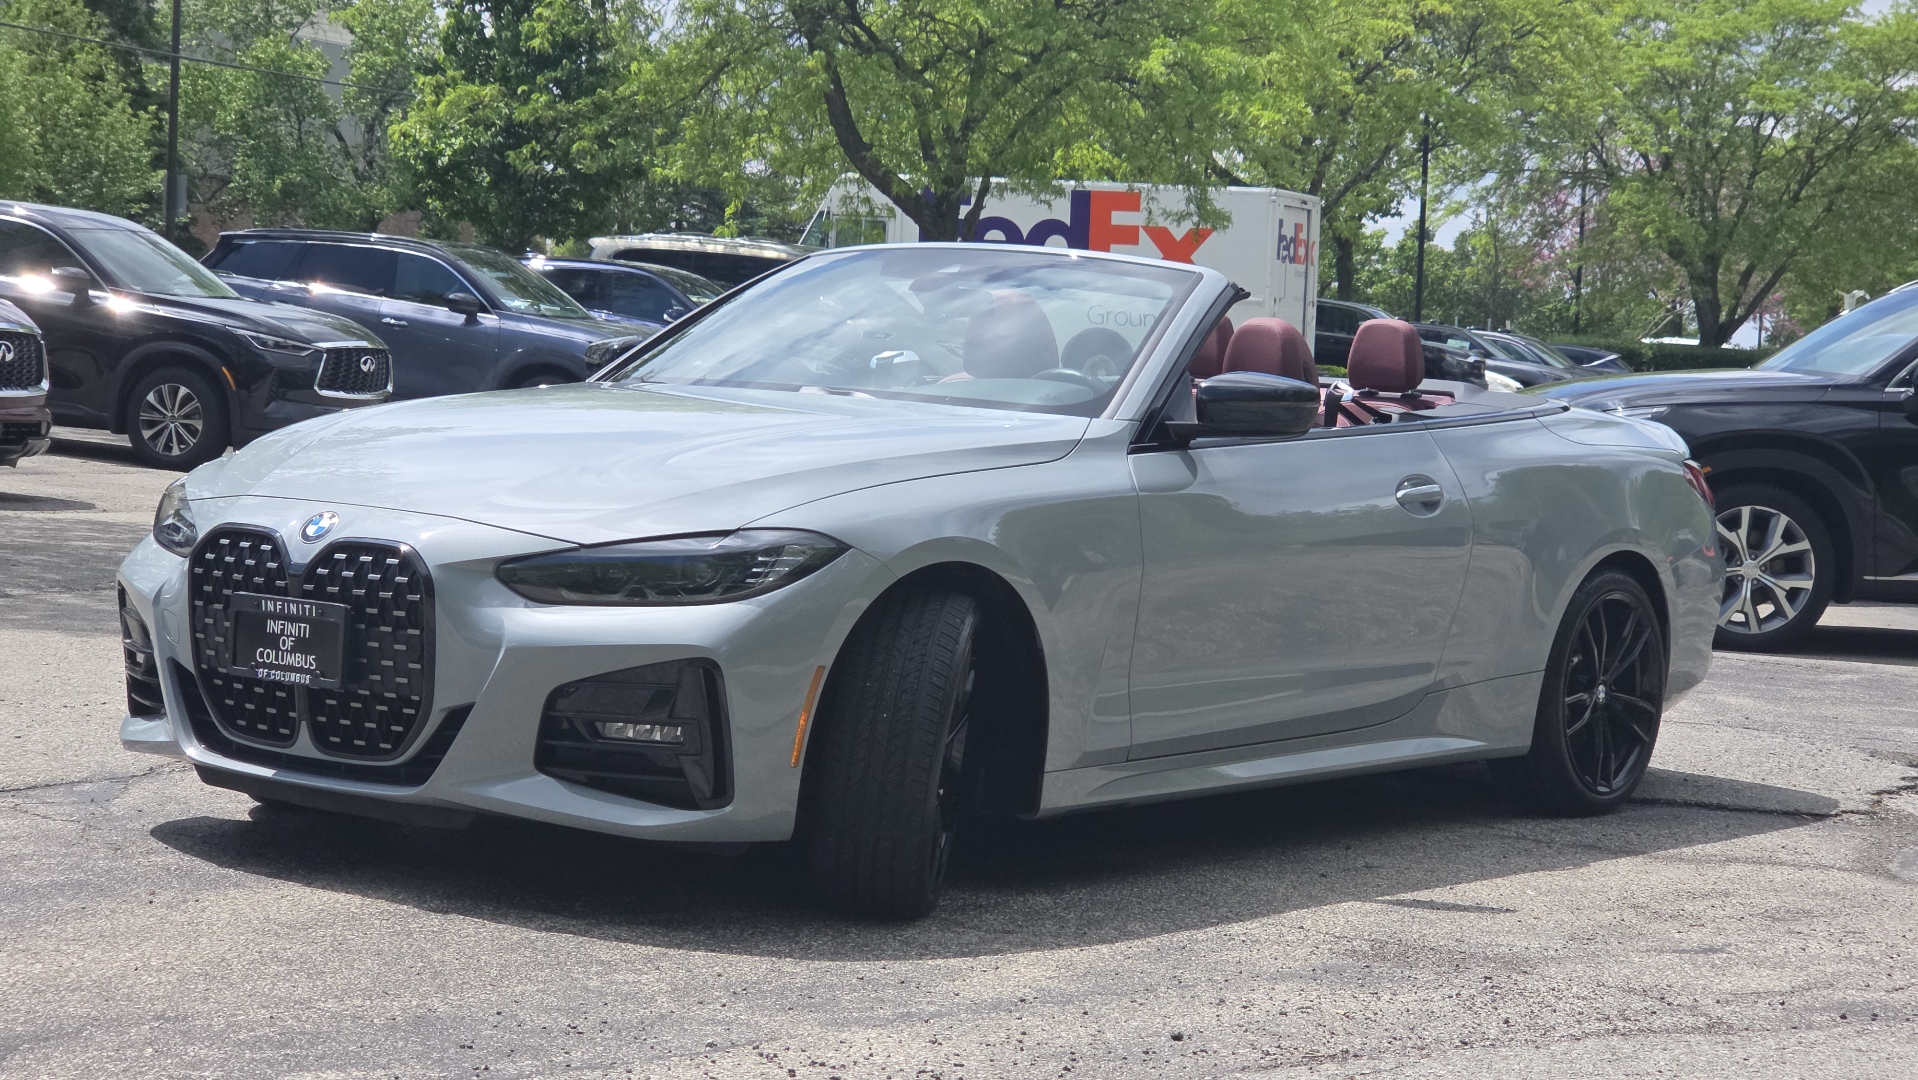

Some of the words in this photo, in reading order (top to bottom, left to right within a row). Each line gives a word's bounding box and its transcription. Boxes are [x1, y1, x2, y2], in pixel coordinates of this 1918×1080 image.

[1277, 218, 1316, 267] FedEx
[1087, 304, 1156, 327] Groun
[261, 599, 316, 617] INFINITI
[266, 618, 310, 638] INFINITI
[279, 636, 296, 651] OF
[256, 647, 316, 670] COLUMBUS
[257, 668, 269, 678] OF
[270, 670, 311, 684] COLUMBUS
